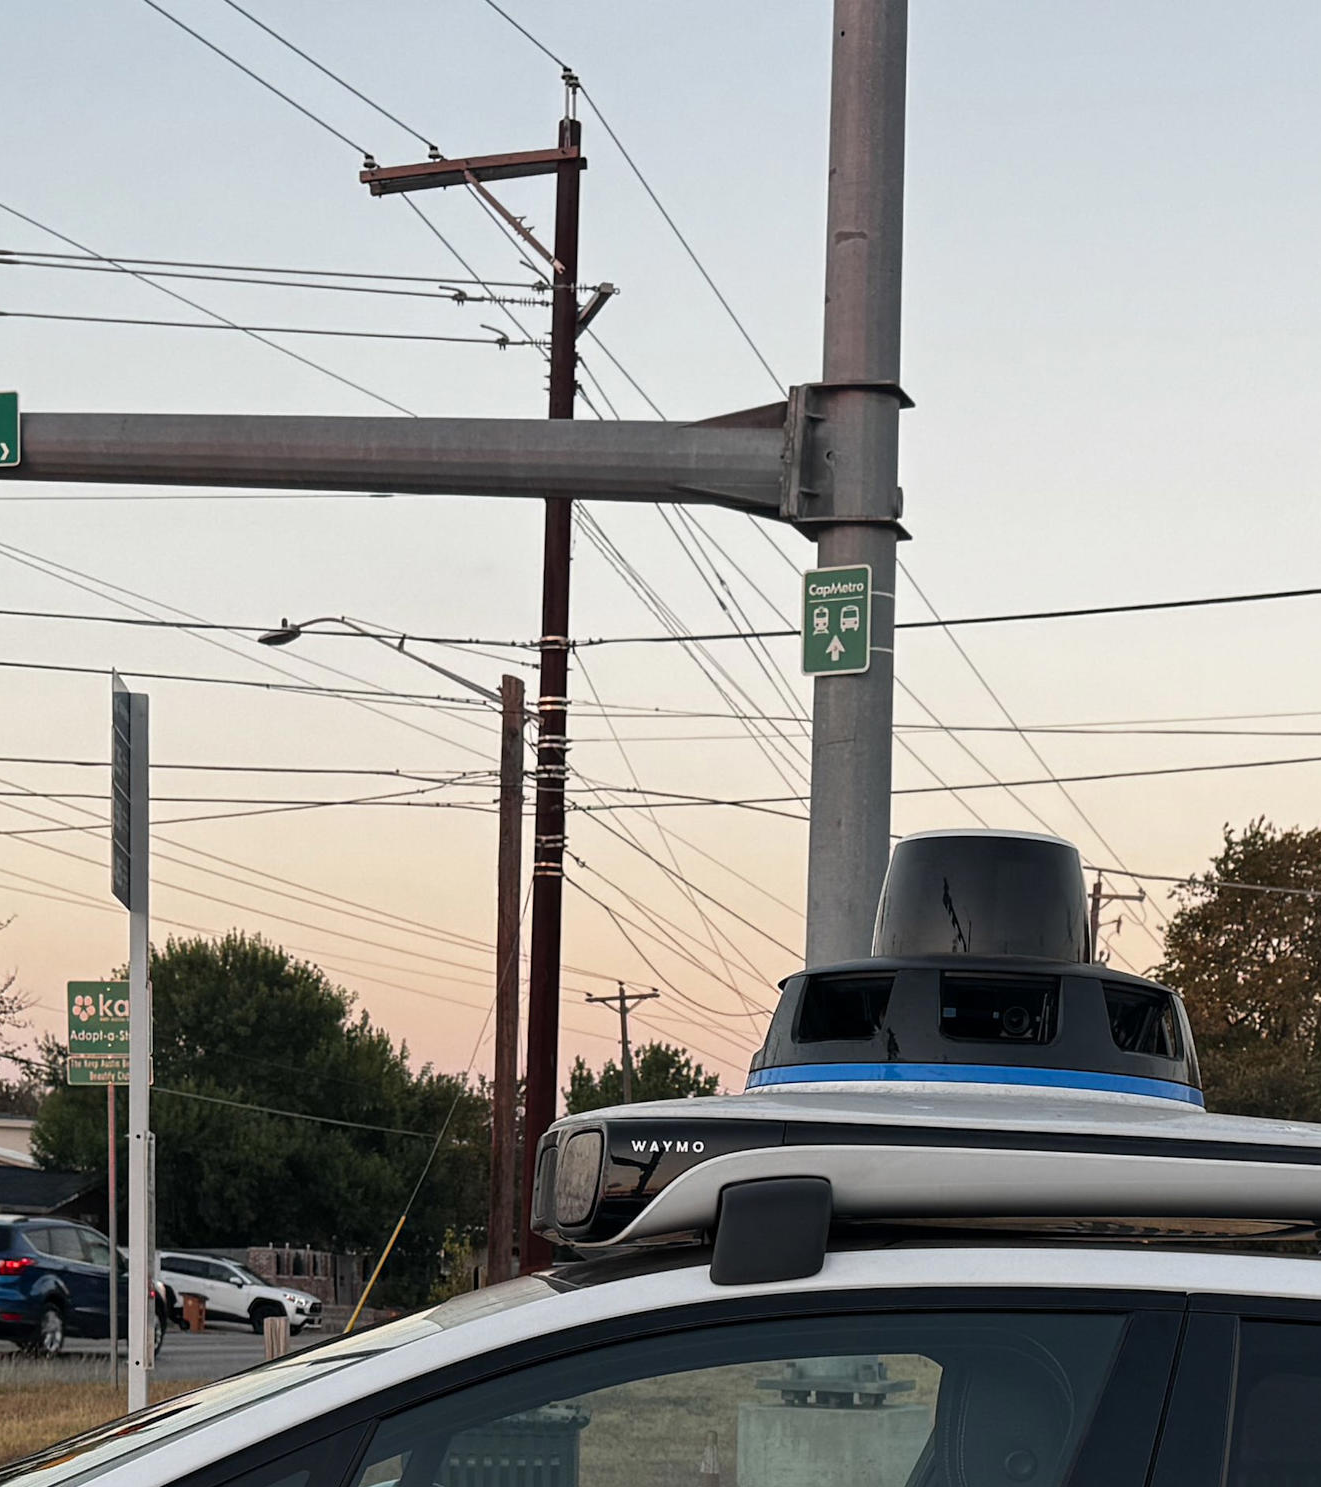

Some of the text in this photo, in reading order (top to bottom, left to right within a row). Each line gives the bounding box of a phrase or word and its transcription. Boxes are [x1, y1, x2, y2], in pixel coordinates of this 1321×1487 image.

[809, 582, 864, 597] CapMetro
[99, 993, 130, 1017] ka
[70, 1030, 130, 1043] Adopt-a-St
[631, 1140, 705, 1153] WAYMO
